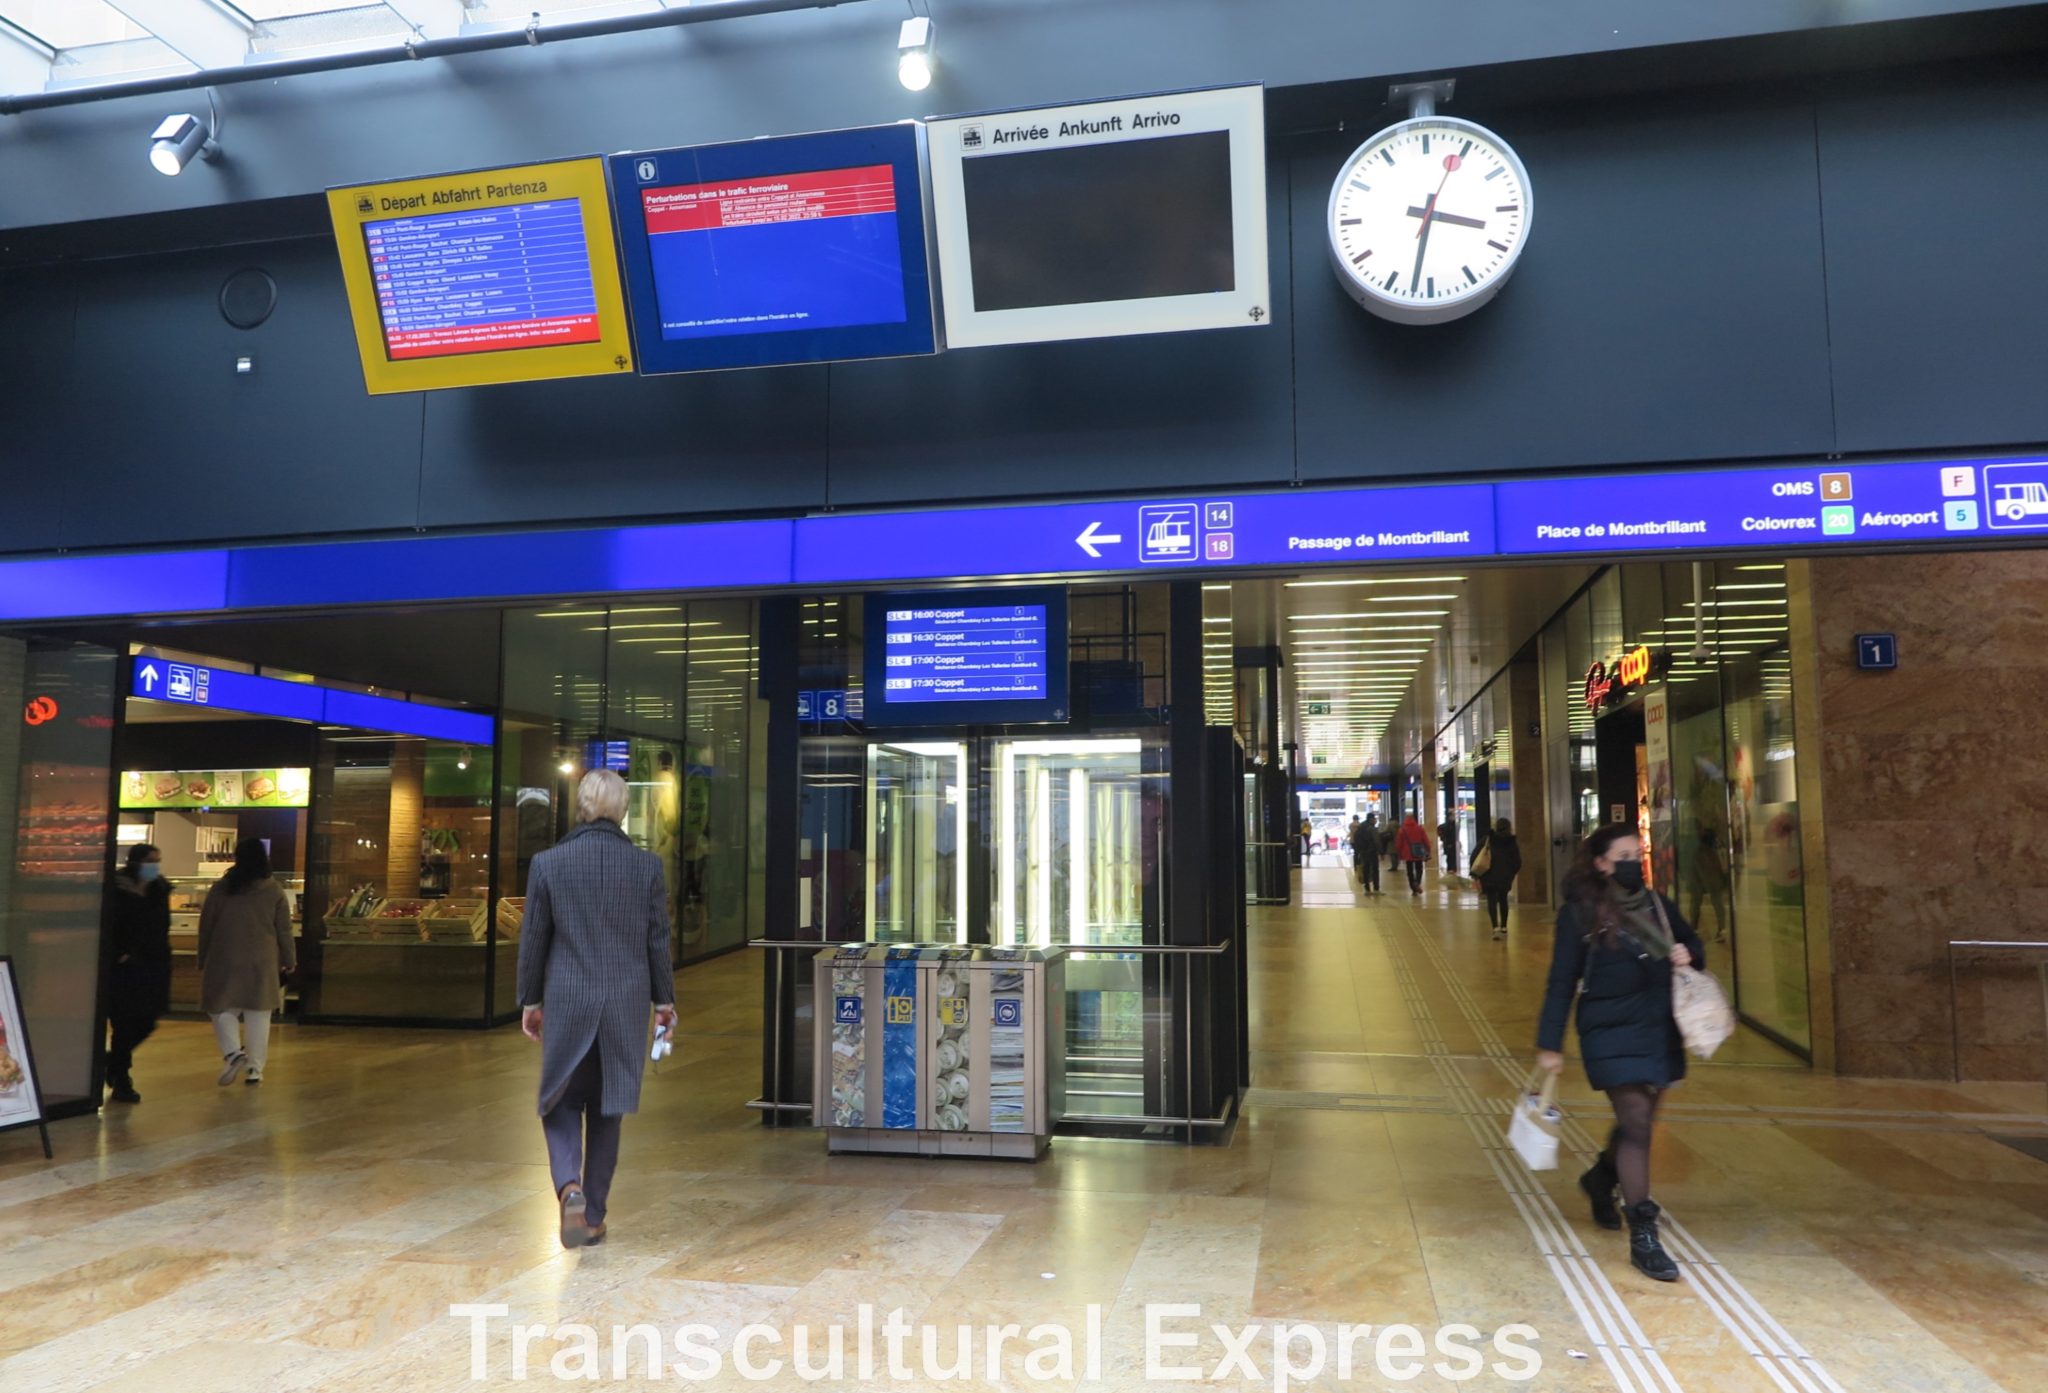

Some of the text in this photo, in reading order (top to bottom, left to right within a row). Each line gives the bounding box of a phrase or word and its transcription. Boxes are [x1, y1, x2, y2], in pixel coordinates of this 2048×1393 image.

[993, 111, 1180, 144] Arrivée Ankunft Arrivo
[381, 181, 548, 211] Départ Abfahrt Partenza
[646, 192, 697, 204] Perturbations
[698, 191, 717, 200] dans
[728, 186, 747, 196] trafic
[748, 184, 789, 194] ferroviaire
[1772, 480, 1842, 496] OMS 8
[1954, 475, 1964, 488] F
[1211, 510, 1228, 522] 14
[1742, 514, 1848, 532] Colovrex 20
[1861, 510, 1966, 527] Aéroport 5
[1537, 519, 1706, 538] Place de Montbrillant
[1211, 540, 1228, 553] 18
[1288, 530, 1470, 550] Passage de Montbrillant
[935, 610, 964, 619] Coppet
[935, 633, 964, 642] Coppet
[935, 656, 964, 664] Coppet
[1872, 645, 1880, 662] 1
[935, 678, 964, 687] Coppet
[825, 698, 838, 716] 8
